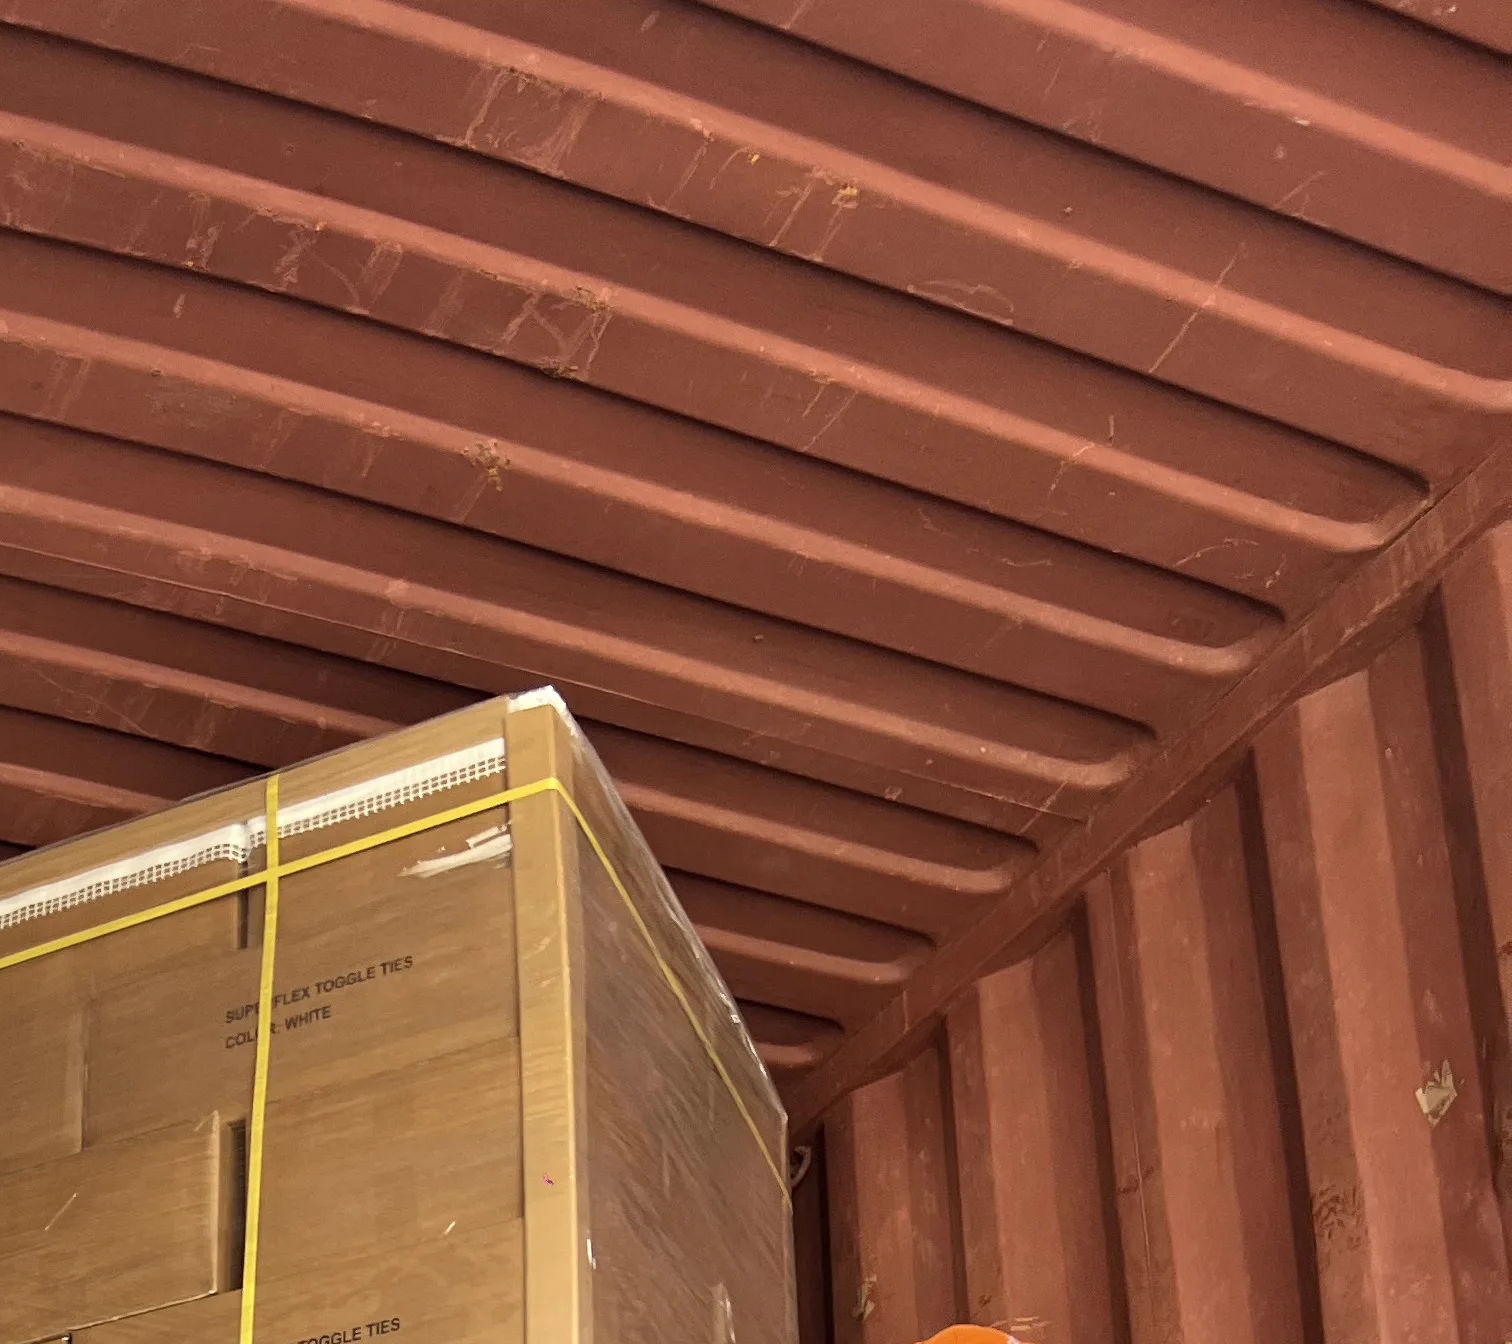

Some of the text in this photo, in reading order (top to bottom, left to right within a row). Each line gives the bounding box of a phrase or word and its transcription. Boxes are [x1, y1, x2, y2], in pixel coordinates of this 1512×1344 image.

[315, 967, 375, 995] TOGGLE
[380, 956, 413, 976] TIES
[285, 1005, 331, 1030] WHITE
[366, 1317, 401, 1337] TIES
